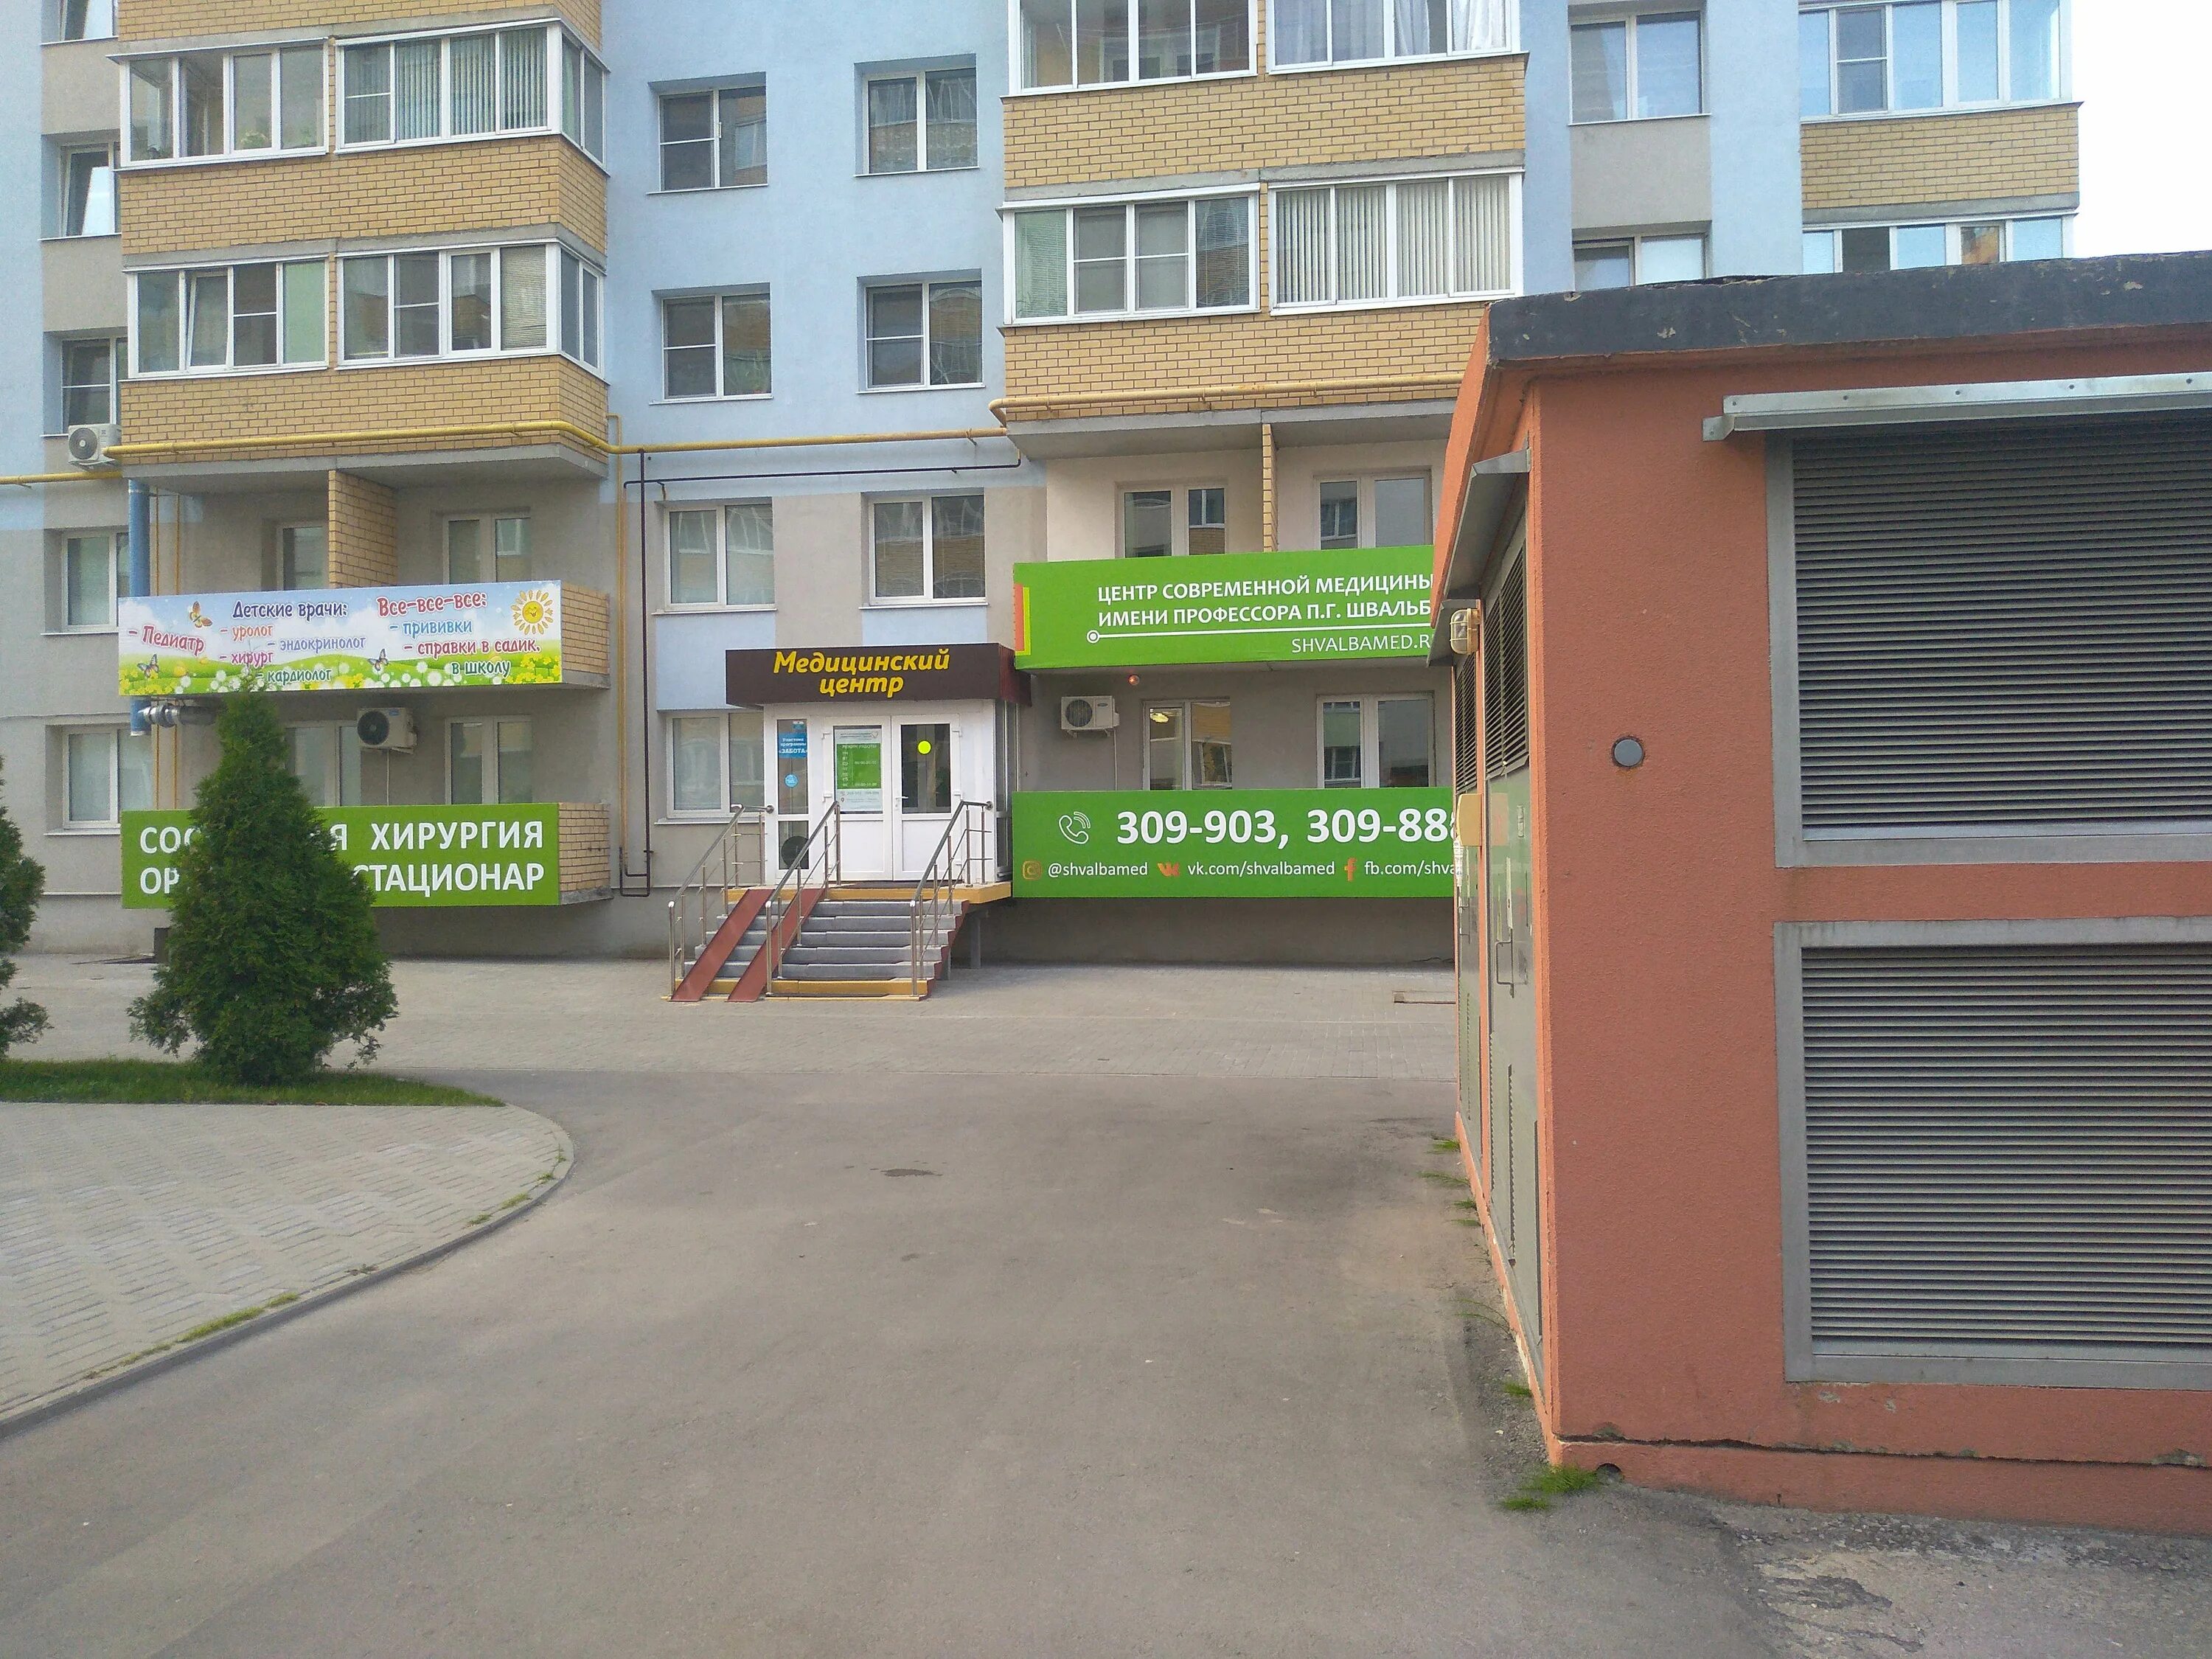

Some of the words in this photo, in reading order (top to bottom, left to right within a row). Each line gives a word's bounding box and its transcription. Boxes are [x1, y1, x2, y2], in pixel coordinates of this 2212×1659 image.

[1098, 584, 1158, 603] ЦЕНТР
[1162, 575, 1310, 599] СОВРЕМЕННОЙ
[1315, 573, 1433, 597] МЕДИЦИНЫ
[232, 600, 293, 618] Детские
[299, 602, 348, 621] врачи:
[377, 592, 487, 616] Все-все-все:
[1098, 608, 1168, 627] ИМЕНИ
[1174, 603, 1301, 625] ПРОФЕССОРА
[1307, 602, 1341, 620] П.Г.
[232, 626, 274, 641] уролог
[403, 620, 472, 639] прививки
[142, 625, 204, 655] Педиатр
[280, 636, 366, 653] эндокринолог
[417, 641, 476, 658] справки
[481, 641, 490, 652] в
[1292, 633, 1434, 653] SHVALBAMED.R
[231, 652, 274, 667] хирург
[452, 662, 459, 675] в
[465, 661, 512, 678] школу
[773, 648, 950, 675] Медицинский
[268, 669, 332, 686] кардиолог
[819, 675, 904, 698] центр
[371, 821, 543, 850] ХИРУРГИЯ
[1117, 810, 1289, 849] 309-903,
[1048, 862, 1147, 878] @shvalbamed
[1187, 860, 1335, 878] vk.com/shvalbamed
